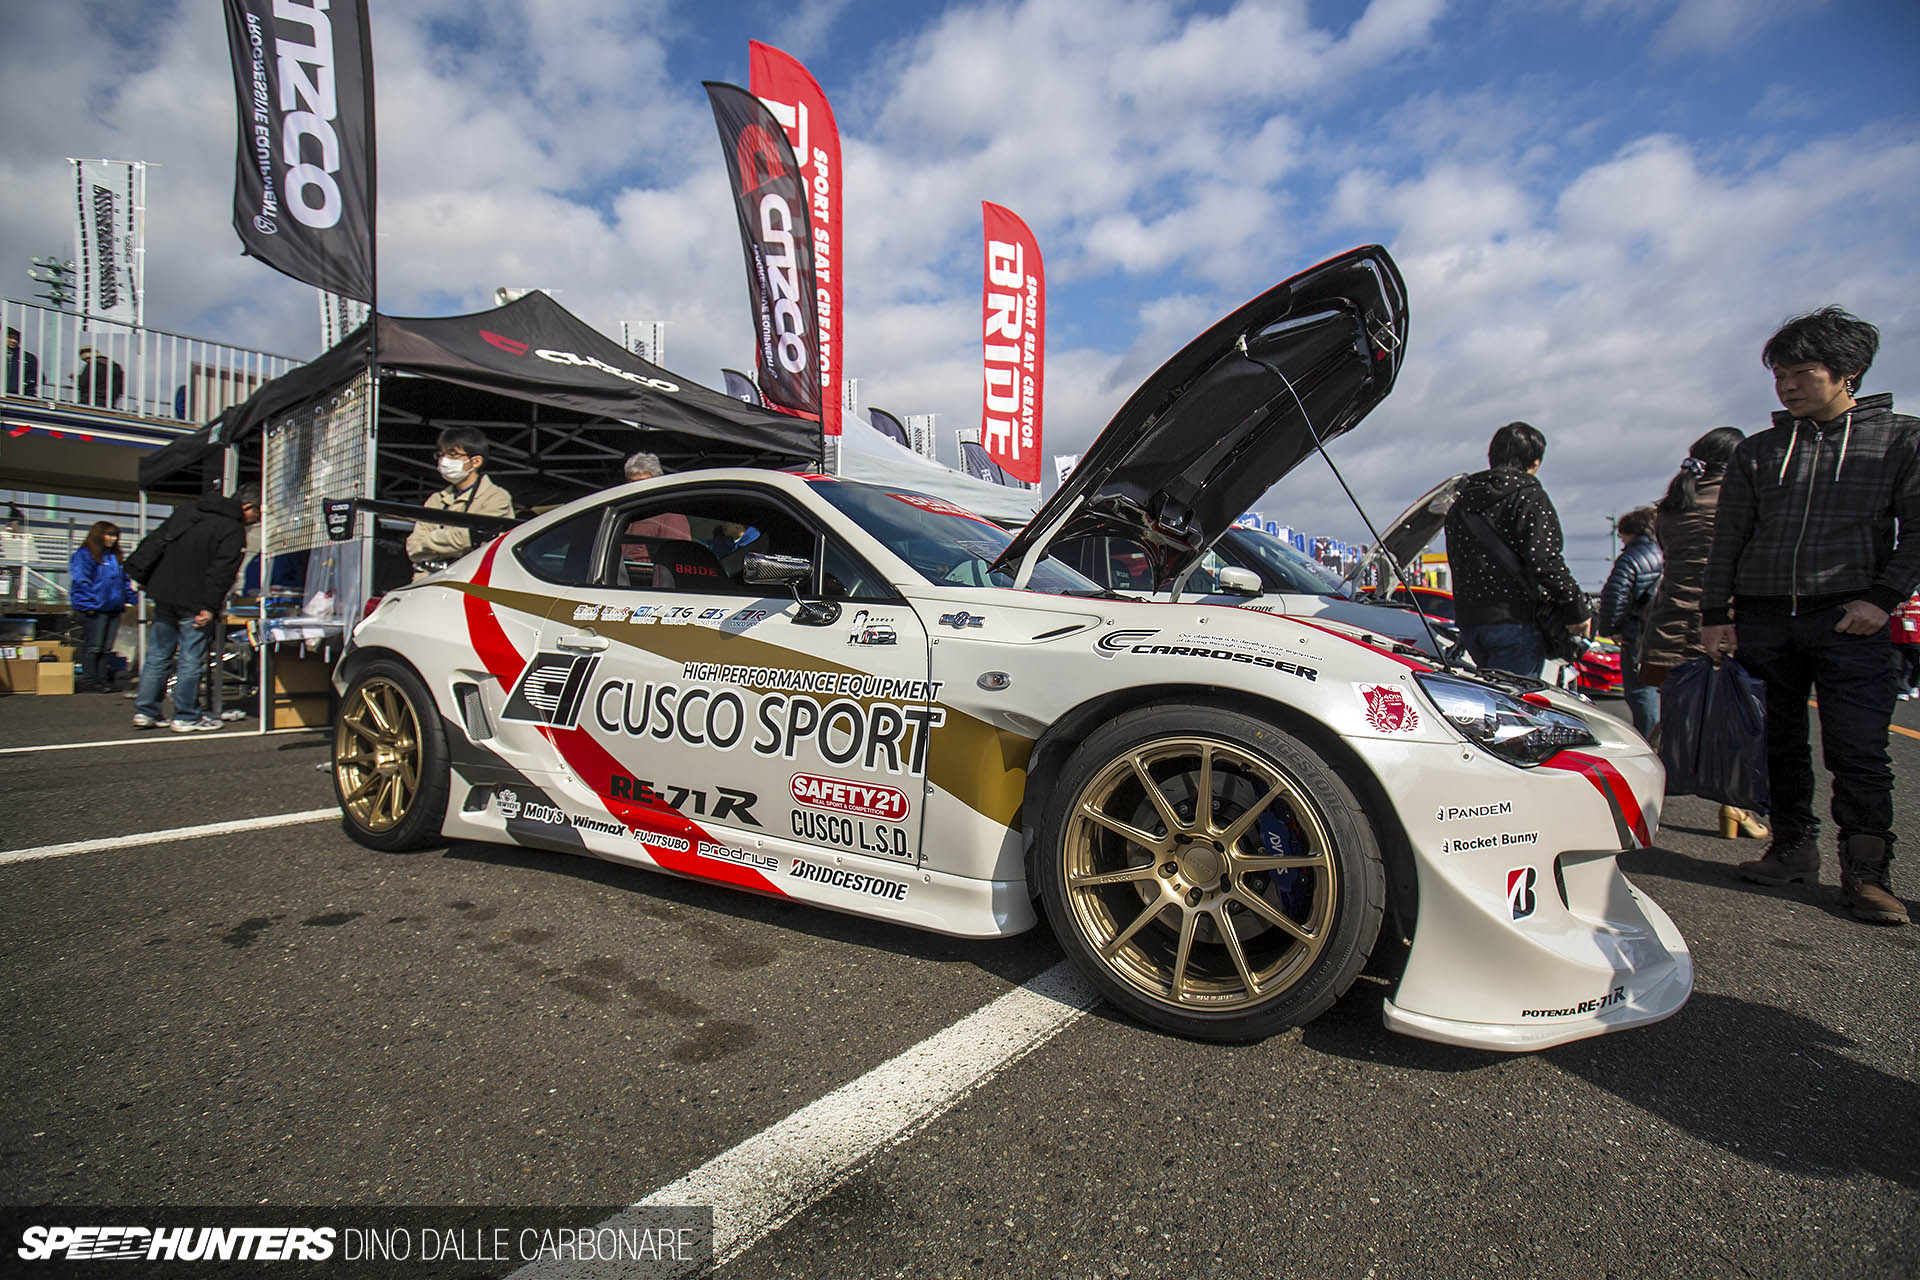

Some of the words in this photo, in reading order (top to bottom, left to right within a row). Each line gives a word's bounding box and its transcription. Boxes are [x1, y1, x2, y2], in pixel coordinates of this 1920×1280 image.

[814, 147, 830, 223] SPORT
[814, 227, 831, 283] SEAT
[1024, 275, 1037, 328] SPORT
[985, 240, 1024, 460] BRIDE
[1023, 331, 1036, 372] SEAT
[1021, 375, 1034, 449] CREATOR
[675, 563, 719, 577] BRIDE
[683, 663, 720, 681] HIGH
[721, 666, 836, 692] PERFORMANCE
[840, 674, 943, 700] EQUIPMENT
[1132, 645, 1318, 682] CARROSSER
[596, 682, 744, 749] CUSCO
[754, 698, 942, 774] SPORT
[525, 804, 563, 823] Moty's
[611, 774, 764, 828] RE-71R
[826, 801, 843, 809] SPORT
[848, 805, 885, 815] COMPETITION
[1448, 802, 1512, 819] PANDEM
[633, 830, 689, 851] FUJITSUBO
[791, 809, 853, 847] CUSCO
[859, 821, 913, 858] L.S.D.
[1453, 836, 1498, 851] Rocket
[1501, 832, 1538, 845] Bunny
[699, 842, 779, 867] prodrive
[789, 859, 908, 900] BRIDGESTONE
[1521, 1008, 1577, 1017] POTENZA
[1577, 985, 1626, 1014] RE-71R
